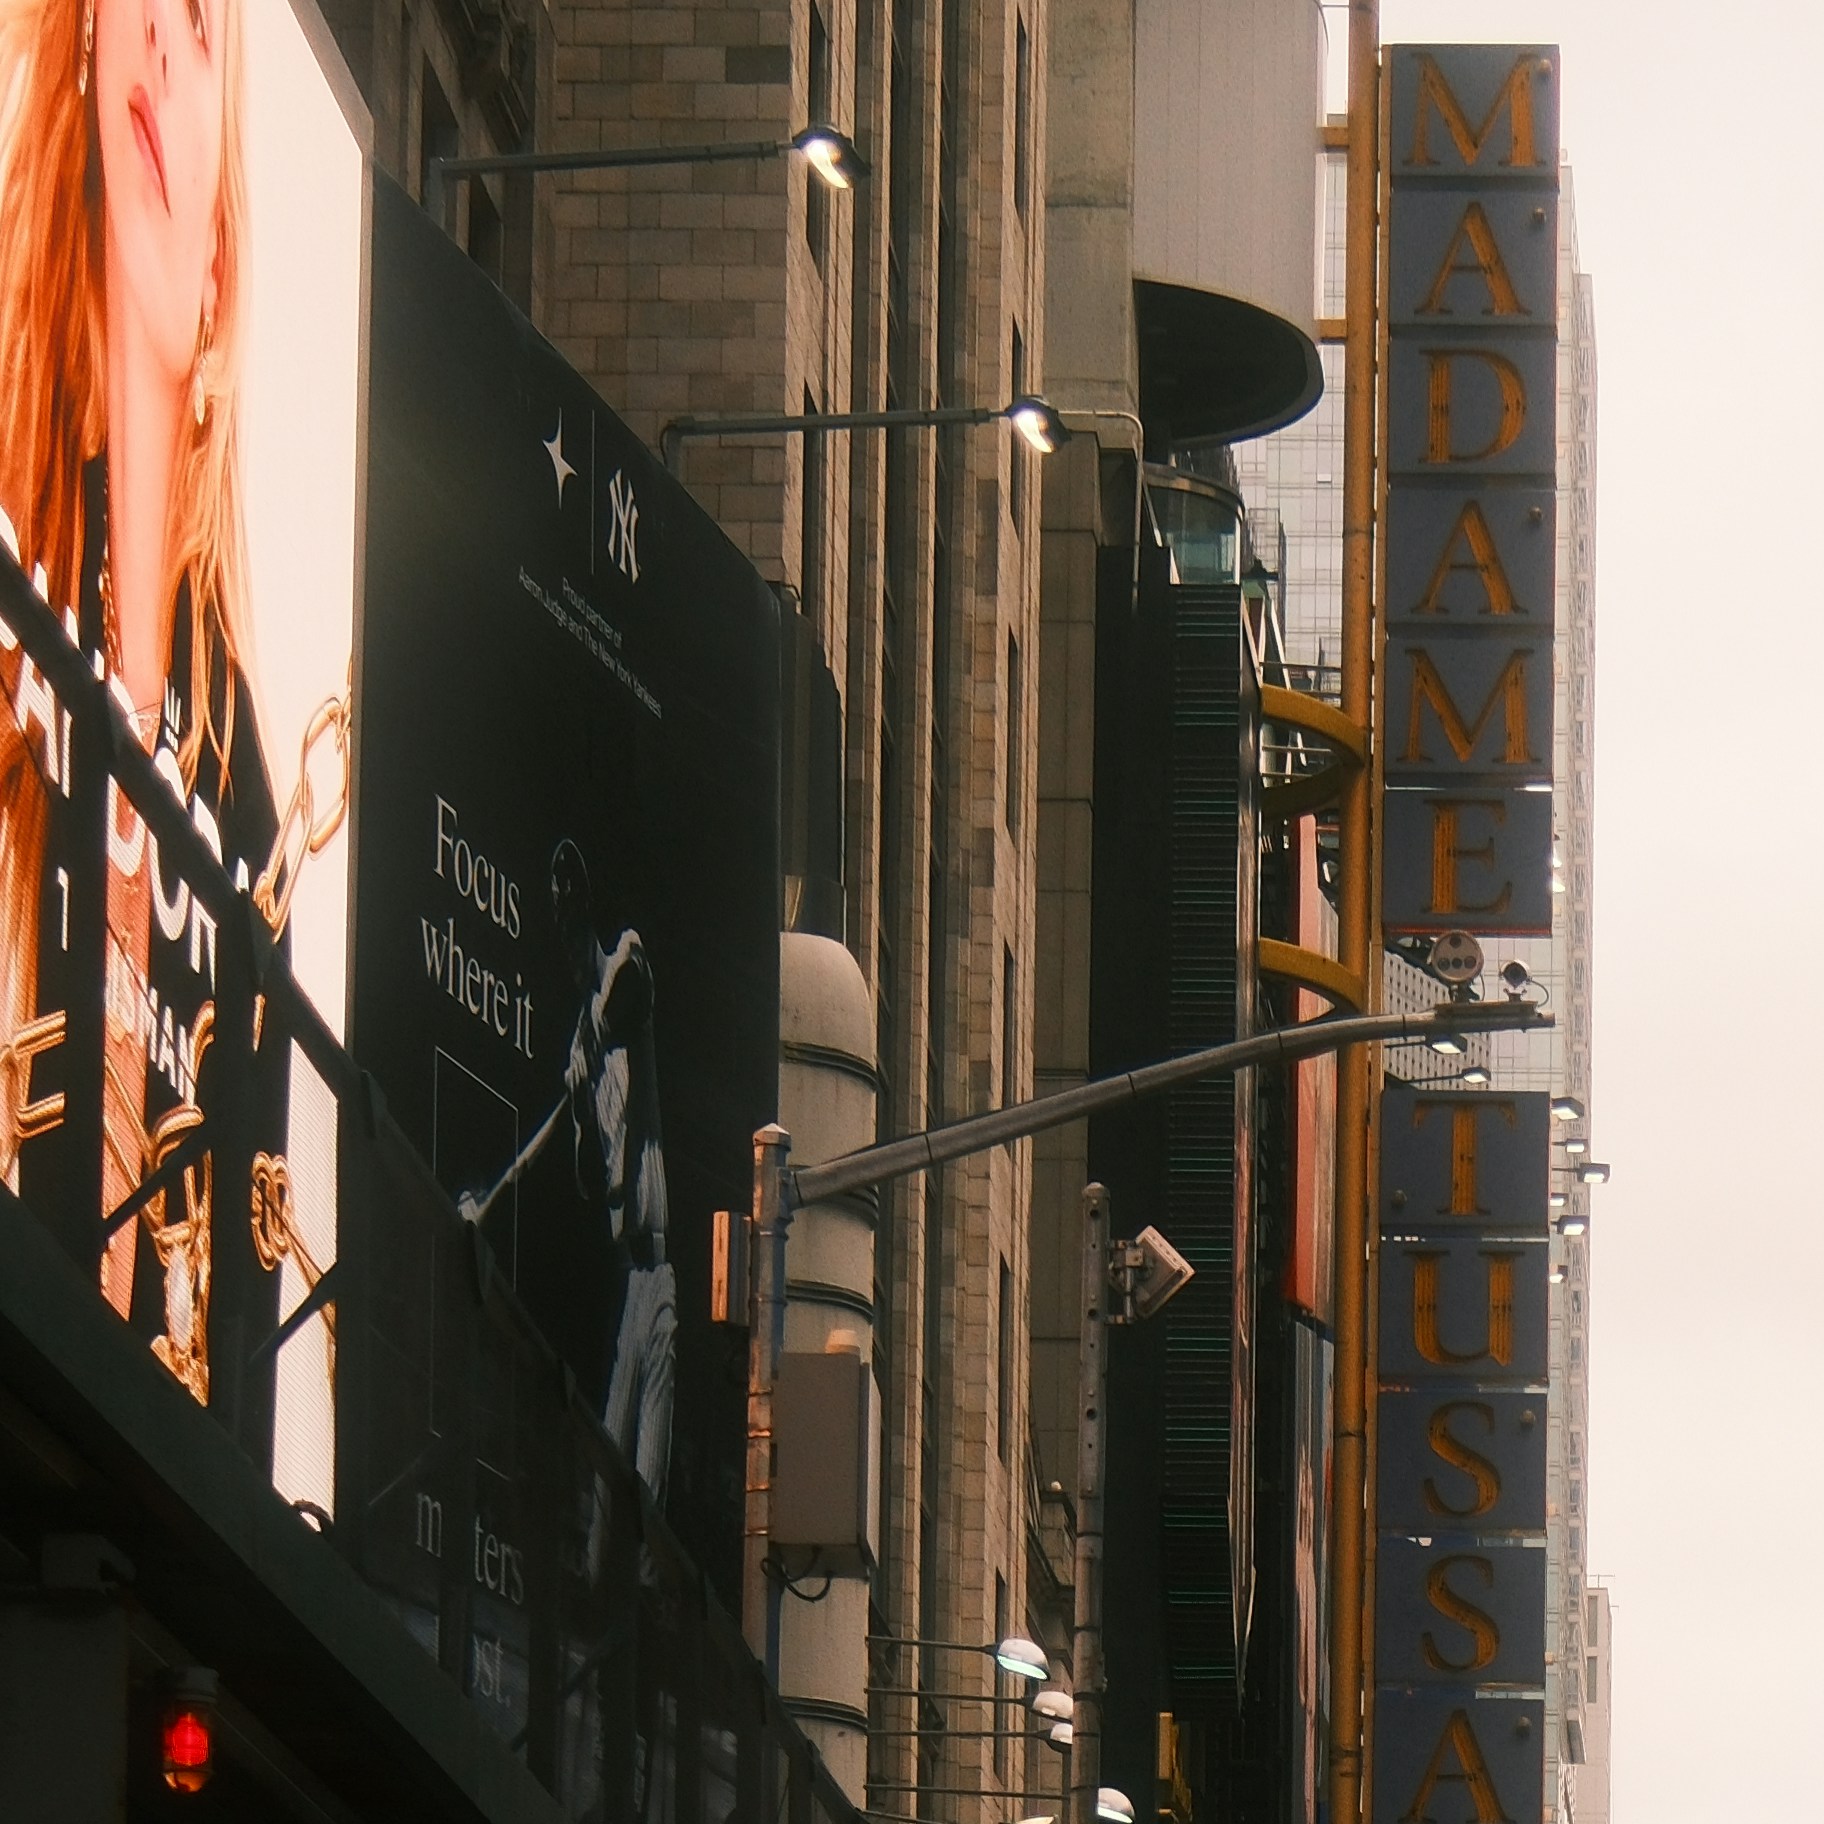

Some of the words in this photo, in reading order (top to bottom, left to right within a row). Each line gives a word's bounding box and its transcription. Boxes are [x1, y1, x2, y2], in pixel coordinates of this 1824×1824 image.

[1404, 52, 1547, 915] MADAME
[519, 565, 543, 602] Aaron
[543, 589, 567, 627] Judge
[568, 615, 583, 642] and
[583, 626, 598, 656] The
[599, 642, 615, 676] New
[616, 657, 632, 689] York
[632, 672, 662, 720] Yankees
[562, 577, 586, 616] Proud
[586, 602, 614, 640] partner
[433, 793, 520, 940] Focus
[420, 915, 508, 1038] where
[513, 971, 534, 1060] it
